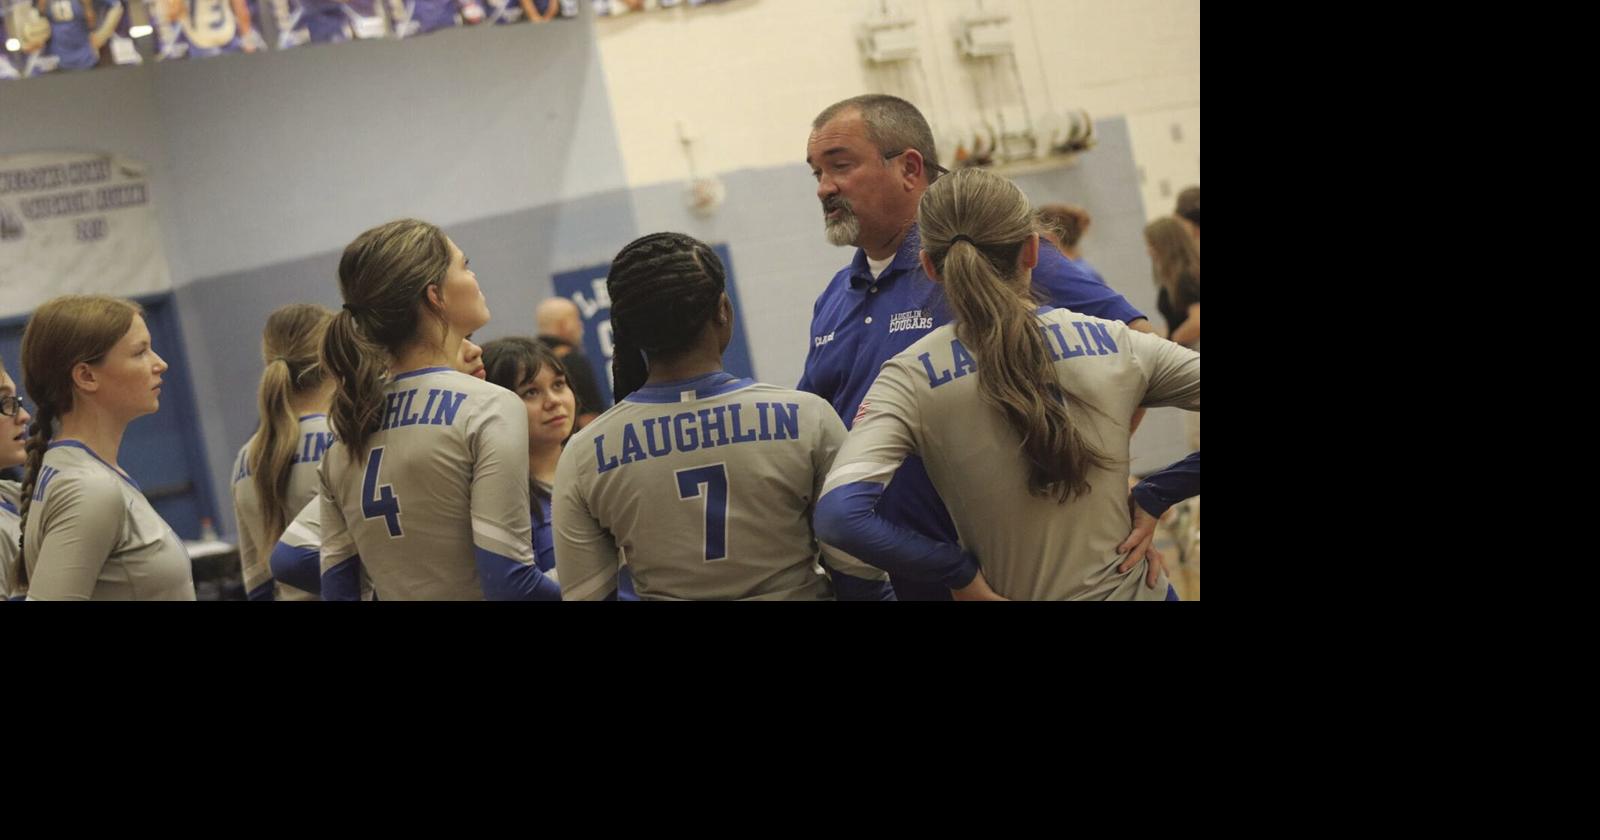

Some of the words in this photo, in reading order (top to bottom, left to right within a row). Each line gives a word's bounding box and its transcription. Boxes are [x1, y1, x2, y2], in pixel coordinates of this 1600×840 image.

[889, 317, 933, 334] COUGARS
[594, 402, 800, 474] LAUGHLIN
[361, 446, 405, 539] 4
[674, 461, 728, 563] 7
